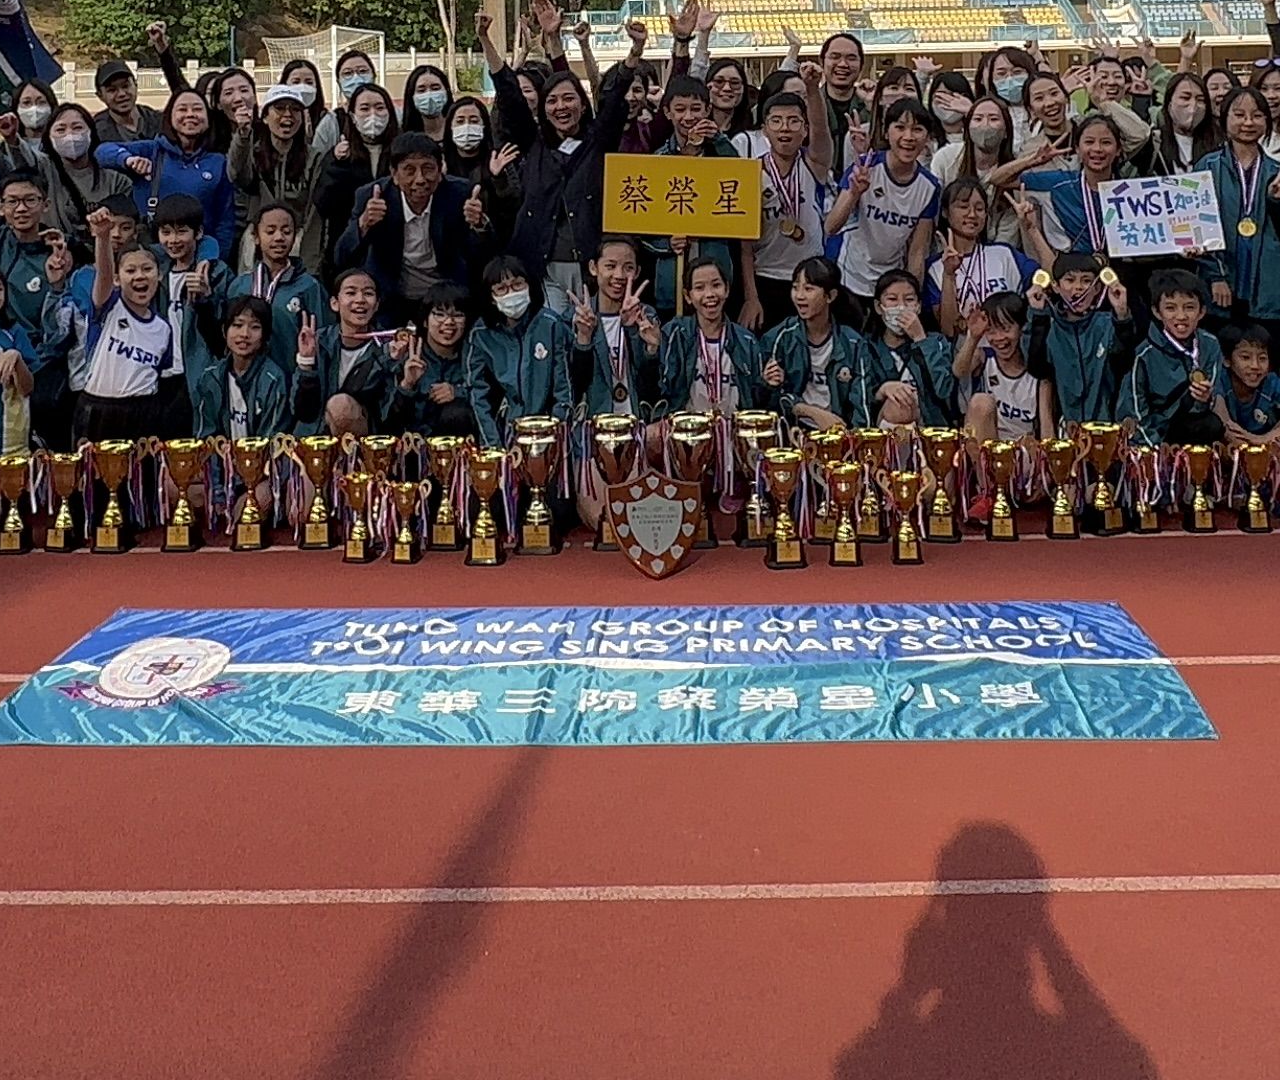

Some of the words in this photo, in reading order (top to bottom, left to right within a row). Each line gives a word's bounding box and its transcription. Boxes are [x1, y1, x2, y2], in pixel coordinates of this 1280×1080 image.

[618, 175, 746, 215] 蔡榮星
[476, 620, 575, 636] WAH
[591, 619, 744, 635] GROUP
[759, 617, 818, 633] OF
[834, 616, 1061, 632] HOSPITALS
[421, 639, 544, 655] WING
[559, 638, 668, 655] SING
[686, 636, 884, 652] PRIMARY
[900, 631, 1098, 650] SCHOOL
